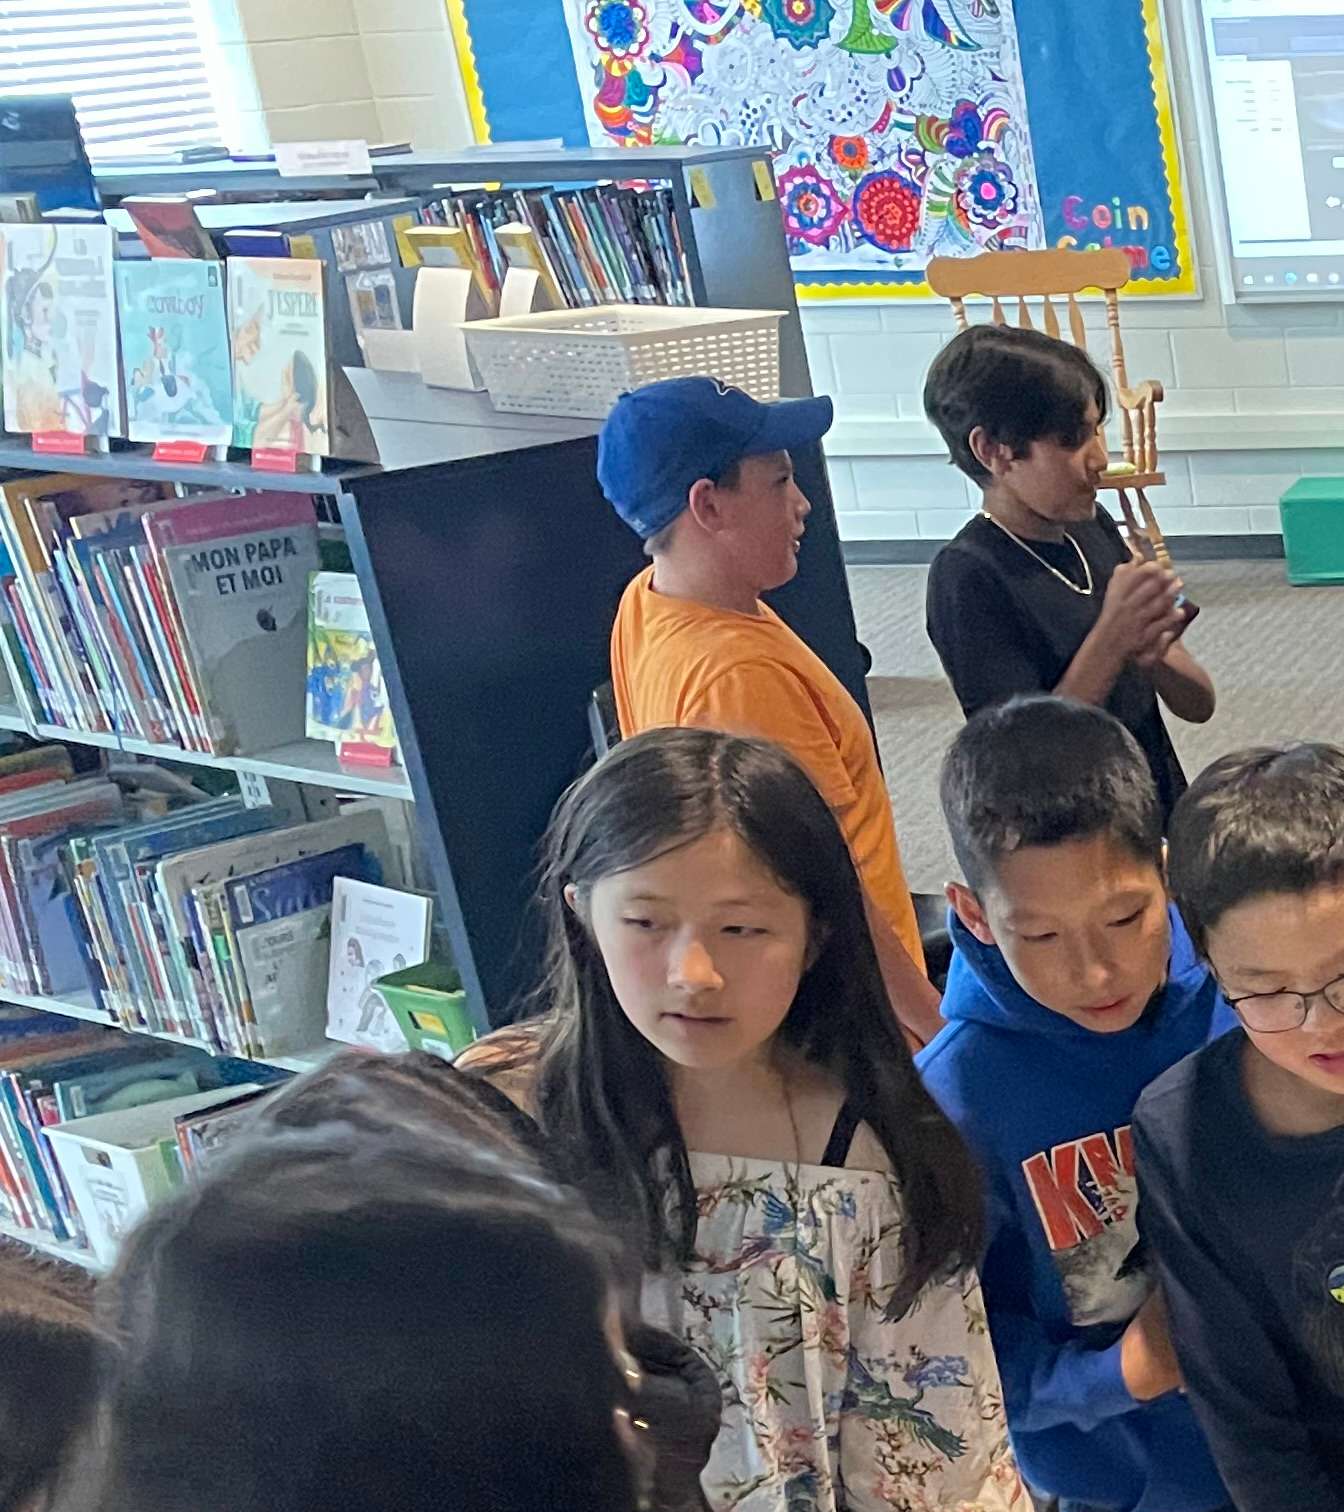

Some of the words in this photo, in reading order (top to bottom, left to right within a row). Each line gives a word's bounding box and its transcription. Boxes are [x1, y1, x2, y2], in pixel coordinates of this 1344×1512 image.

[1063, 195, 1149, 230] Coin
[191, 547, 242, 573] MON
[244, 536, 297, 563] PAPA
[216, 575, 237, 596] ET
[243, 565, 283, 591] MOI
